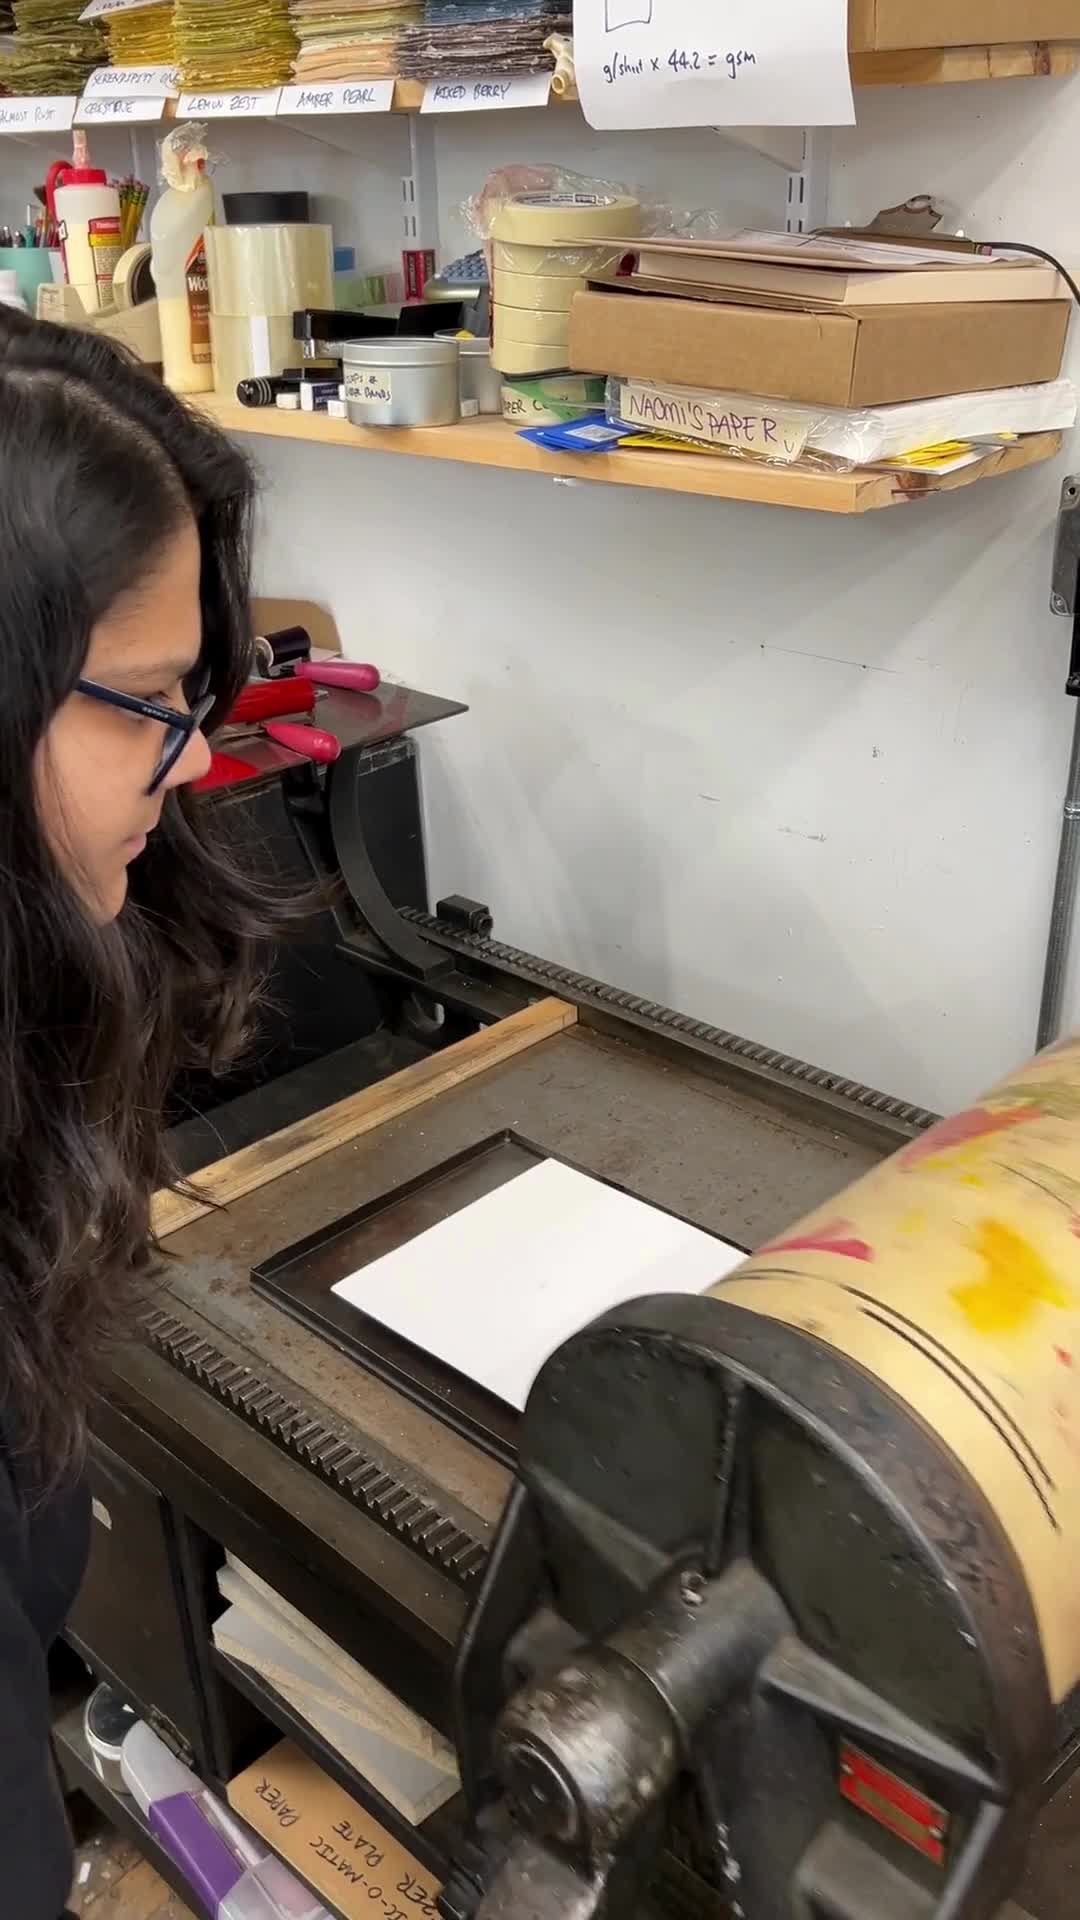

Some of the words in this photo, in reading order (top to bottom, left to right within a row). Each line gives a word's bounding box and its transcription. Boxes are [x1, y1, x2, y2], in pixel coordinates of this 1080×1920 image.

[667, 49, 701, 73] 44.2
[725, 50, 756, 80] gsm
[342, 87, 377, 105] PEARL
[473, 81, 512, 101] BERRY
[707, 411, 778, 443] PAPER
[255, 1776, 301, 1828] PAPER
